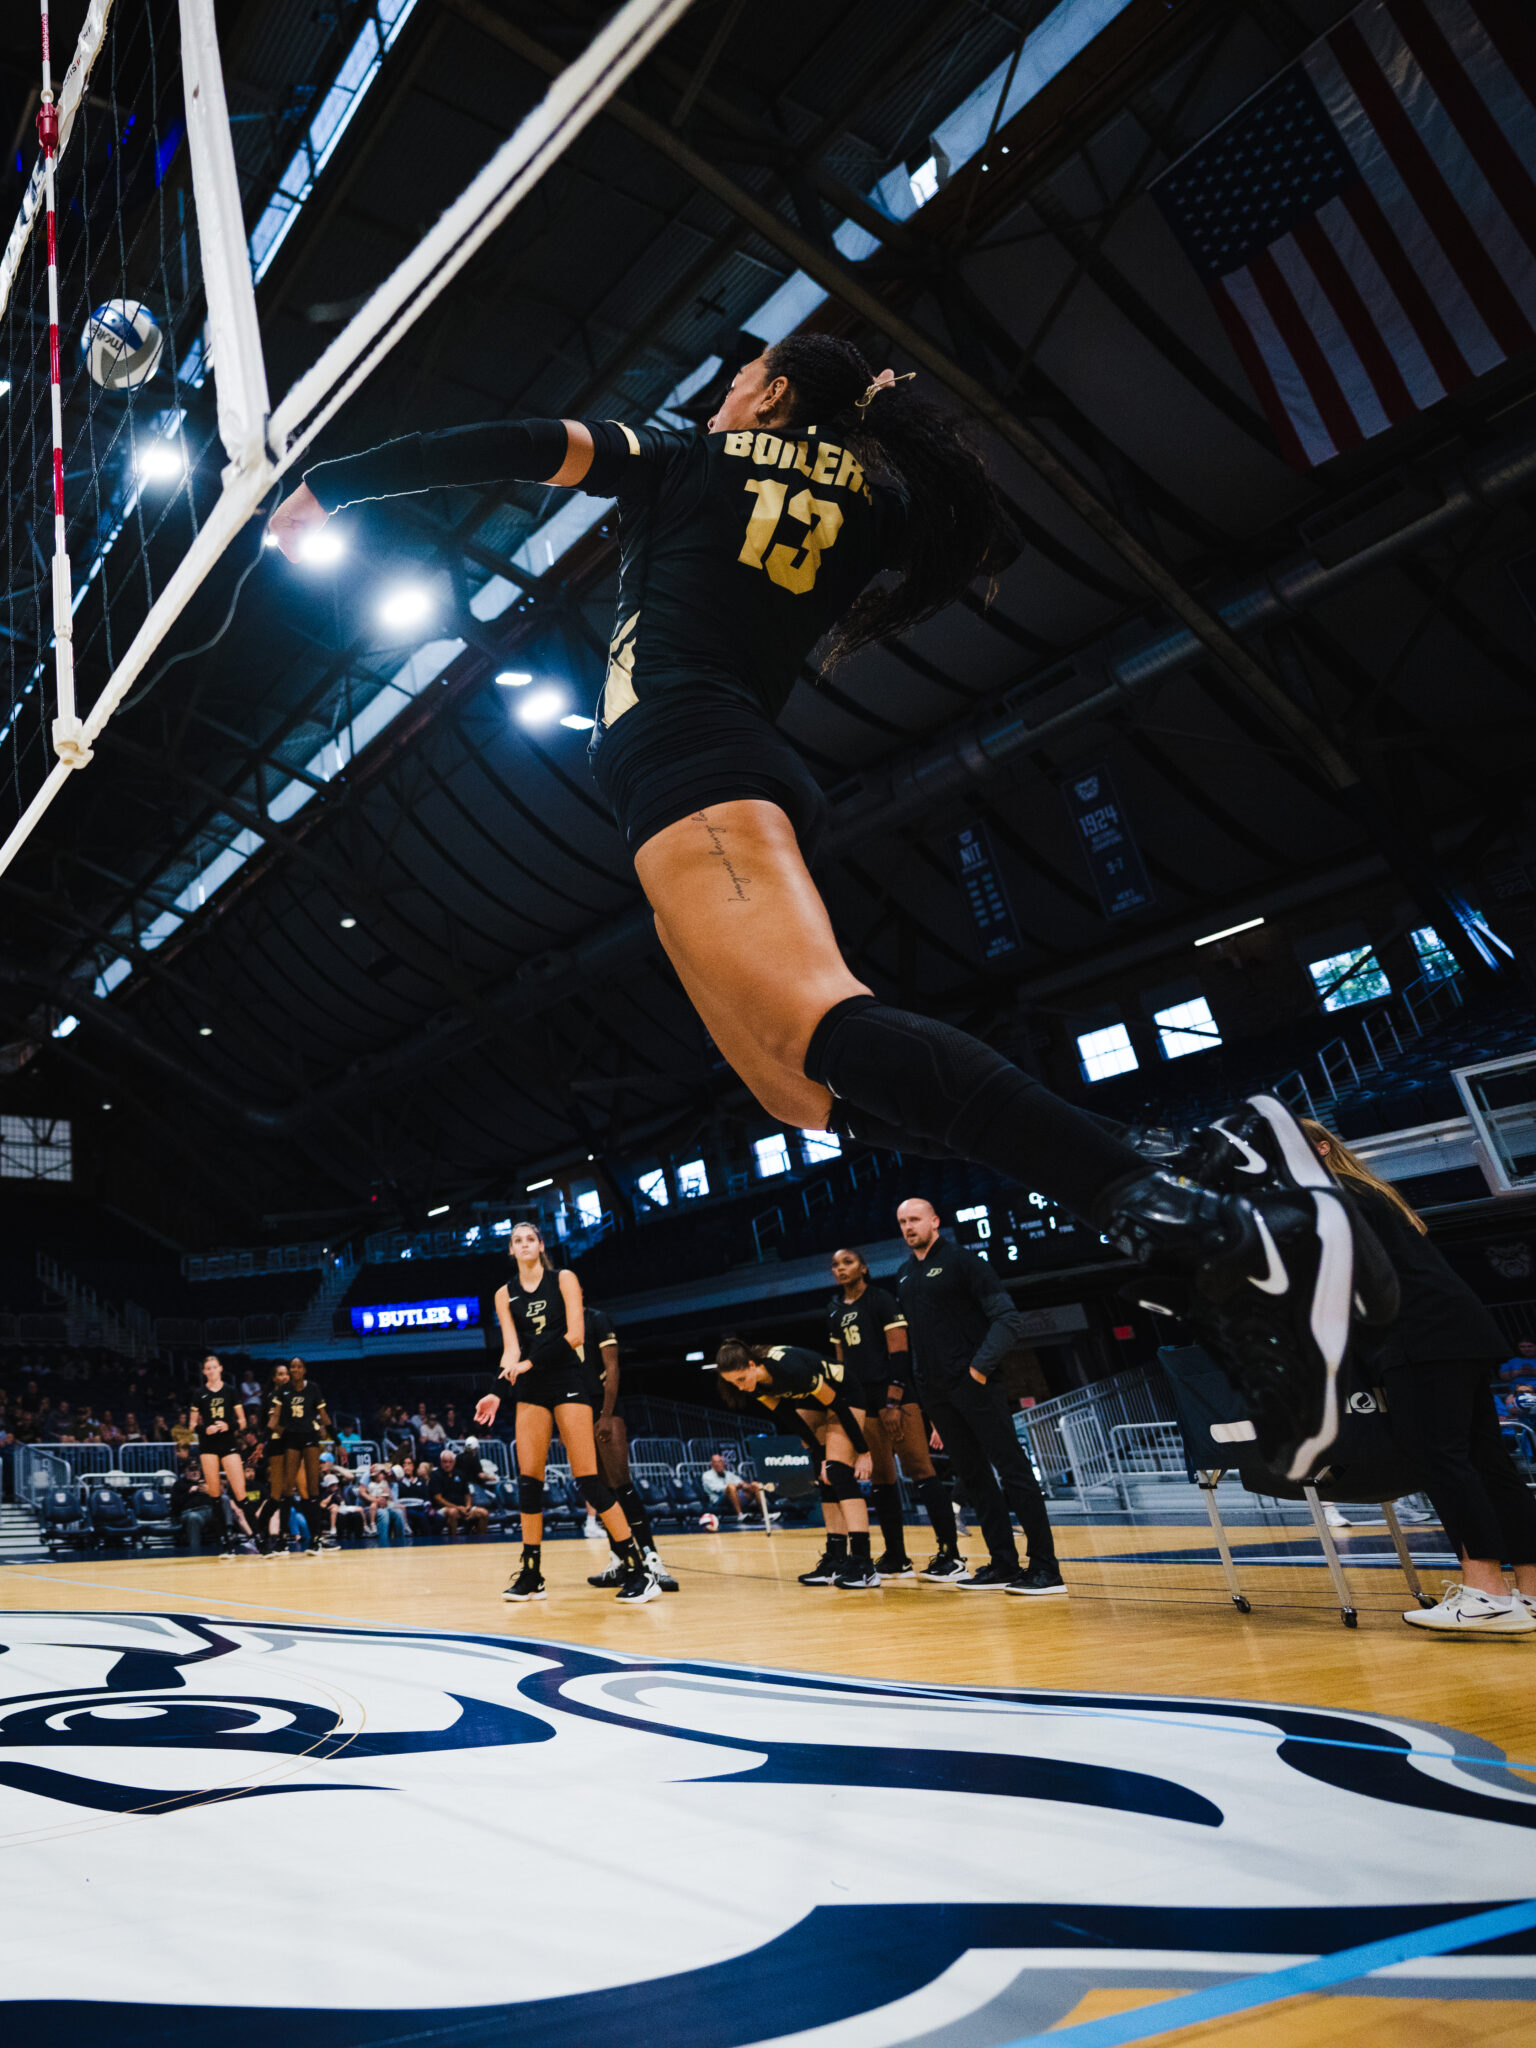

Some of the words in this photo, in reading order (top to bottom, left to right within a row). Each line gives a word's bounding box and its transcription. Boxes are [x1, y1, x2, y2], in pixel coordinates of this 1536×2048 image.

[737, 478, 844, 595] 13
[1079, 804, 1118, 837] 1924
[960, 842, 982, 866] NIT
[378, 1306, 452, 1328] BUTLER
[843, 1324, 861, 1347] 16
[210, 1406, 224, 1418] 14
[764, 1454, 809, 1466] molten
